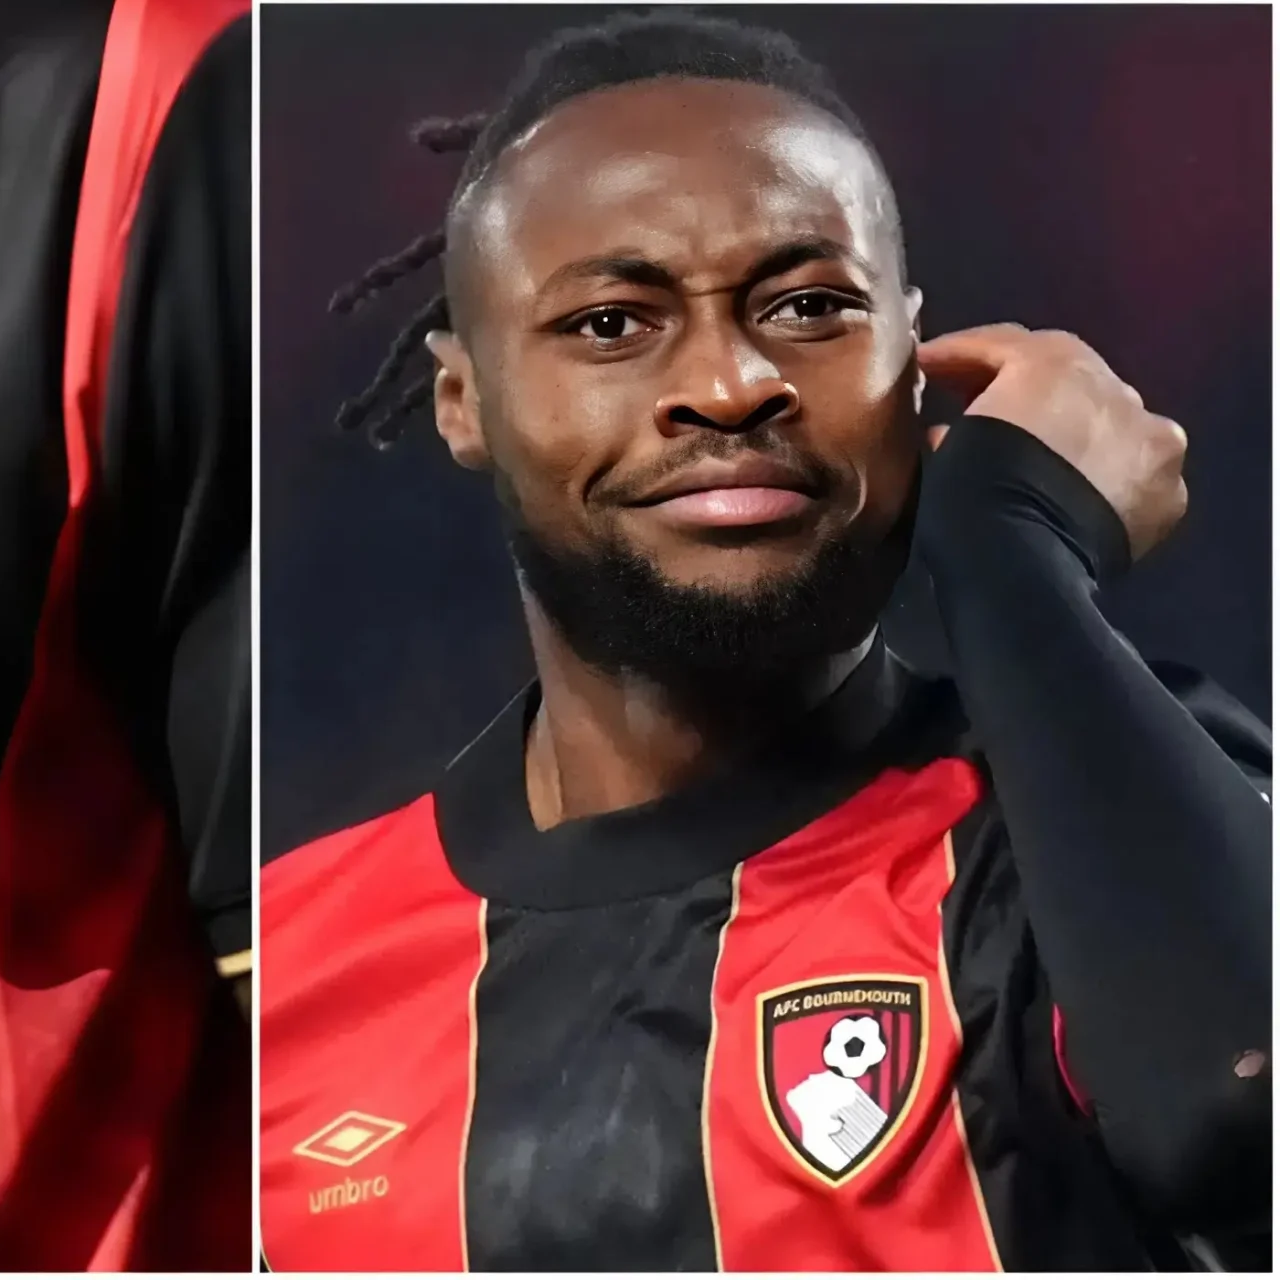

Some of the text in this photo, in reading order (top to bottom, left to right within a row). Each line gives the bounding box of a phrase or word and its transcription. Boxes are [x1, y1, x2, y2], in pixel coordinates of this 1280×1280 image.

[773, 989, 911, 1018] AFC BOURNEMOUTH
[308, 1175, 390, 1214] umbro
